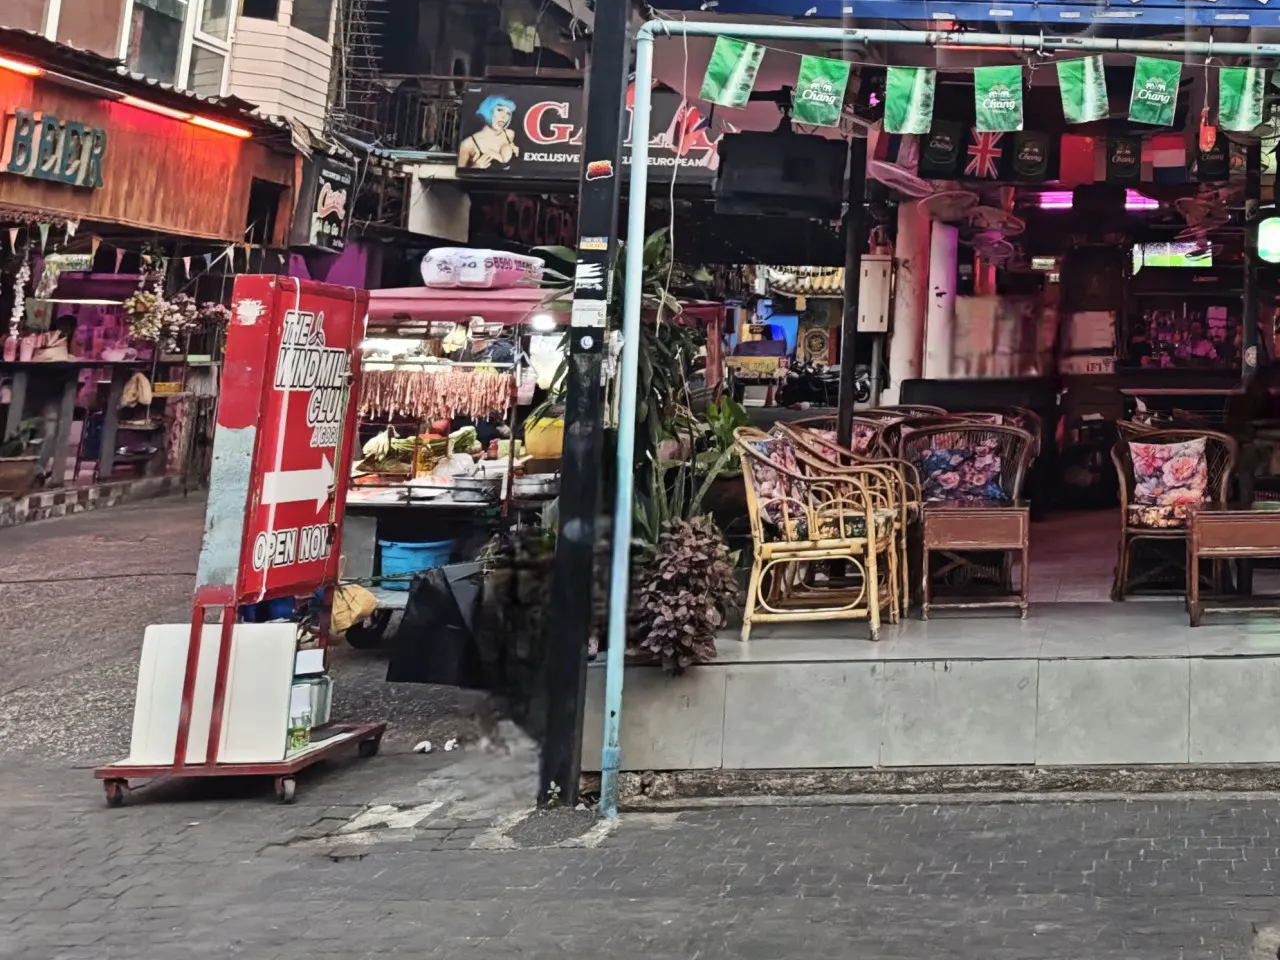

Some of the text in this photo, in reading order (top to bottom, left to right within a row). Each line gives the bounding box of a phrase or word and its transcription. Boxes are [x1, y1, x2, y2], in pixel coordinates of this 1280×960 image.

[802, 87, 836, 106] Chang
[982, 98, 1016, 112] Chang
[1138, 88, 1171, 105] Chang
[7, 107, 107, 188] BEER
[523, 152, 580, 163] EXCLUSIVE
[283, 312, 313, 346] THE
[254, 529, 297, 571] OPEN
